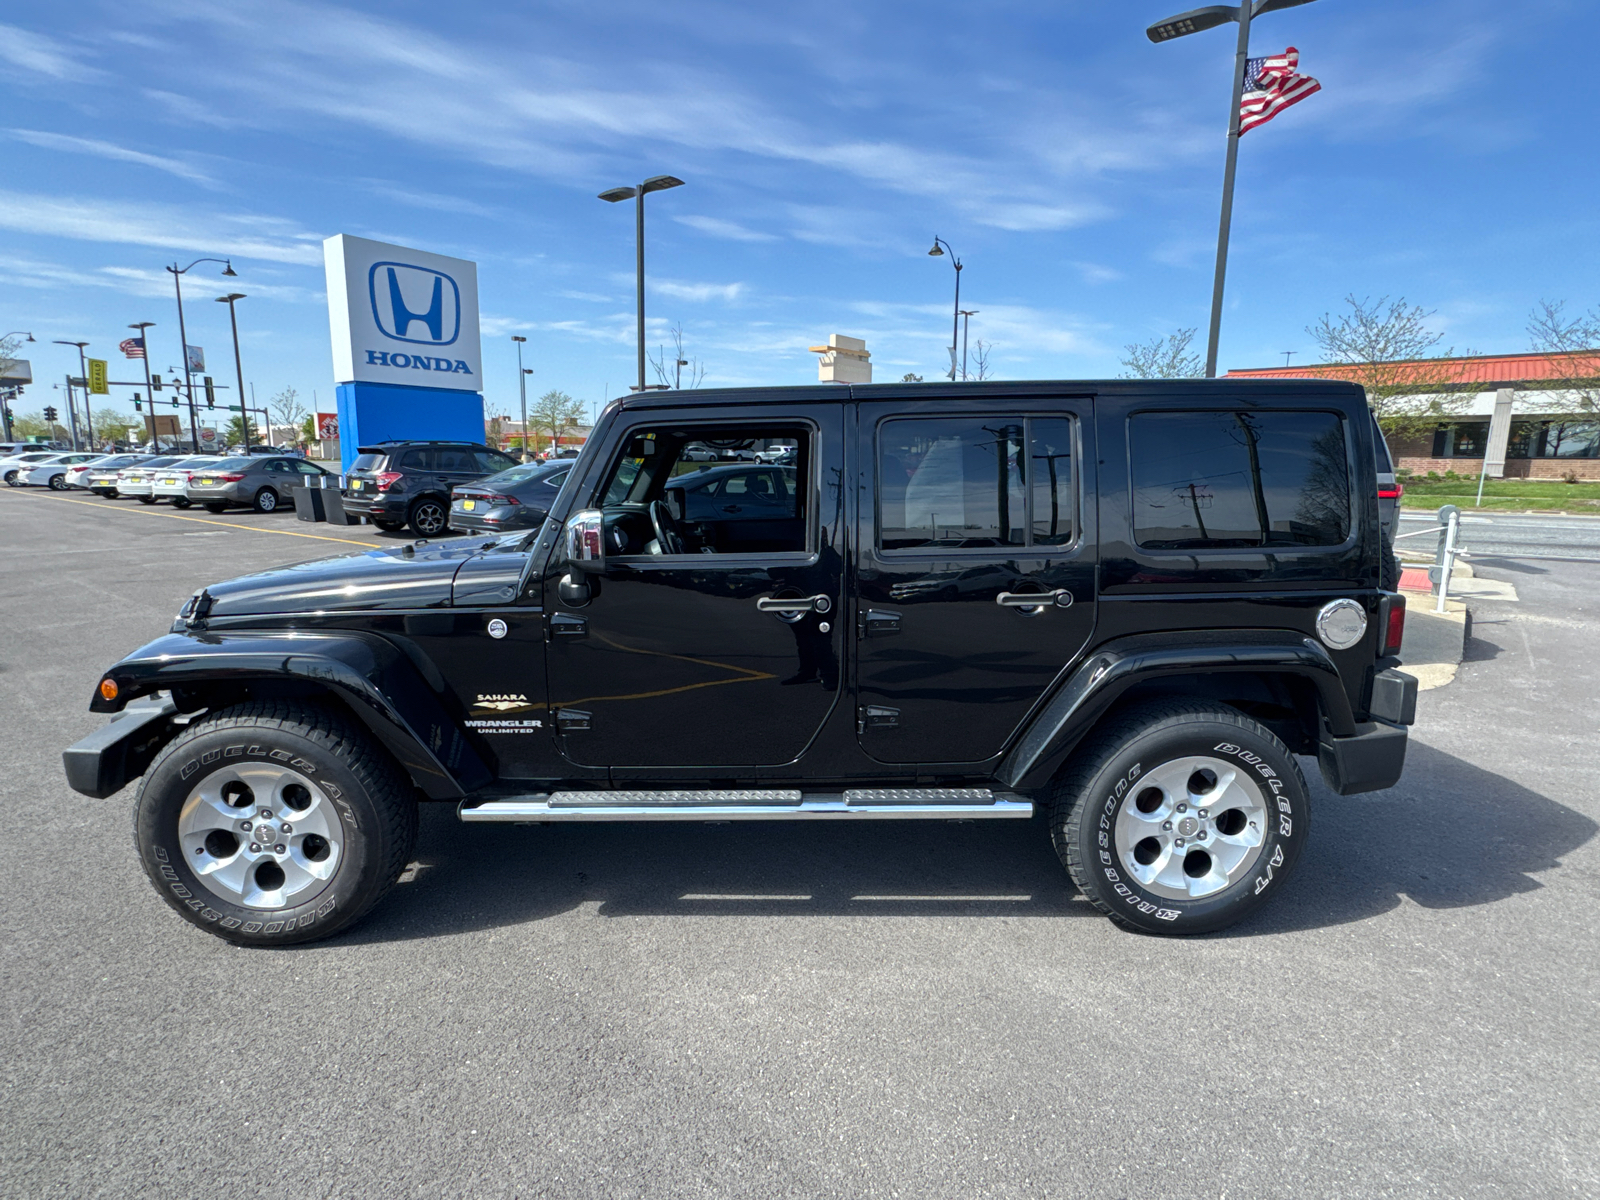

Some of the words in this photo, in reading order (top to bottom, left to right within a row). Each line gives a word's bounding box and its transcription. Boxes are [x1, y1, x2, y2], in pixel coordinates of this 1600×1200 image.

[94, 363, 102, 390] GERALD
[365, 350, 473, 374] HONDA
[464, 720, 542, 728] WRANGLER
[180, 745, 318, 781] DUELER
[320, 780, 359, 829] A/T
[1213, 742, 1292, 837] DUELER
[1254, 844, 1284, 895] A/T
[1099, 763, 1182, 921] BRIDGESTONE
[153, 846, 337, 934] BRIDGESTONE
